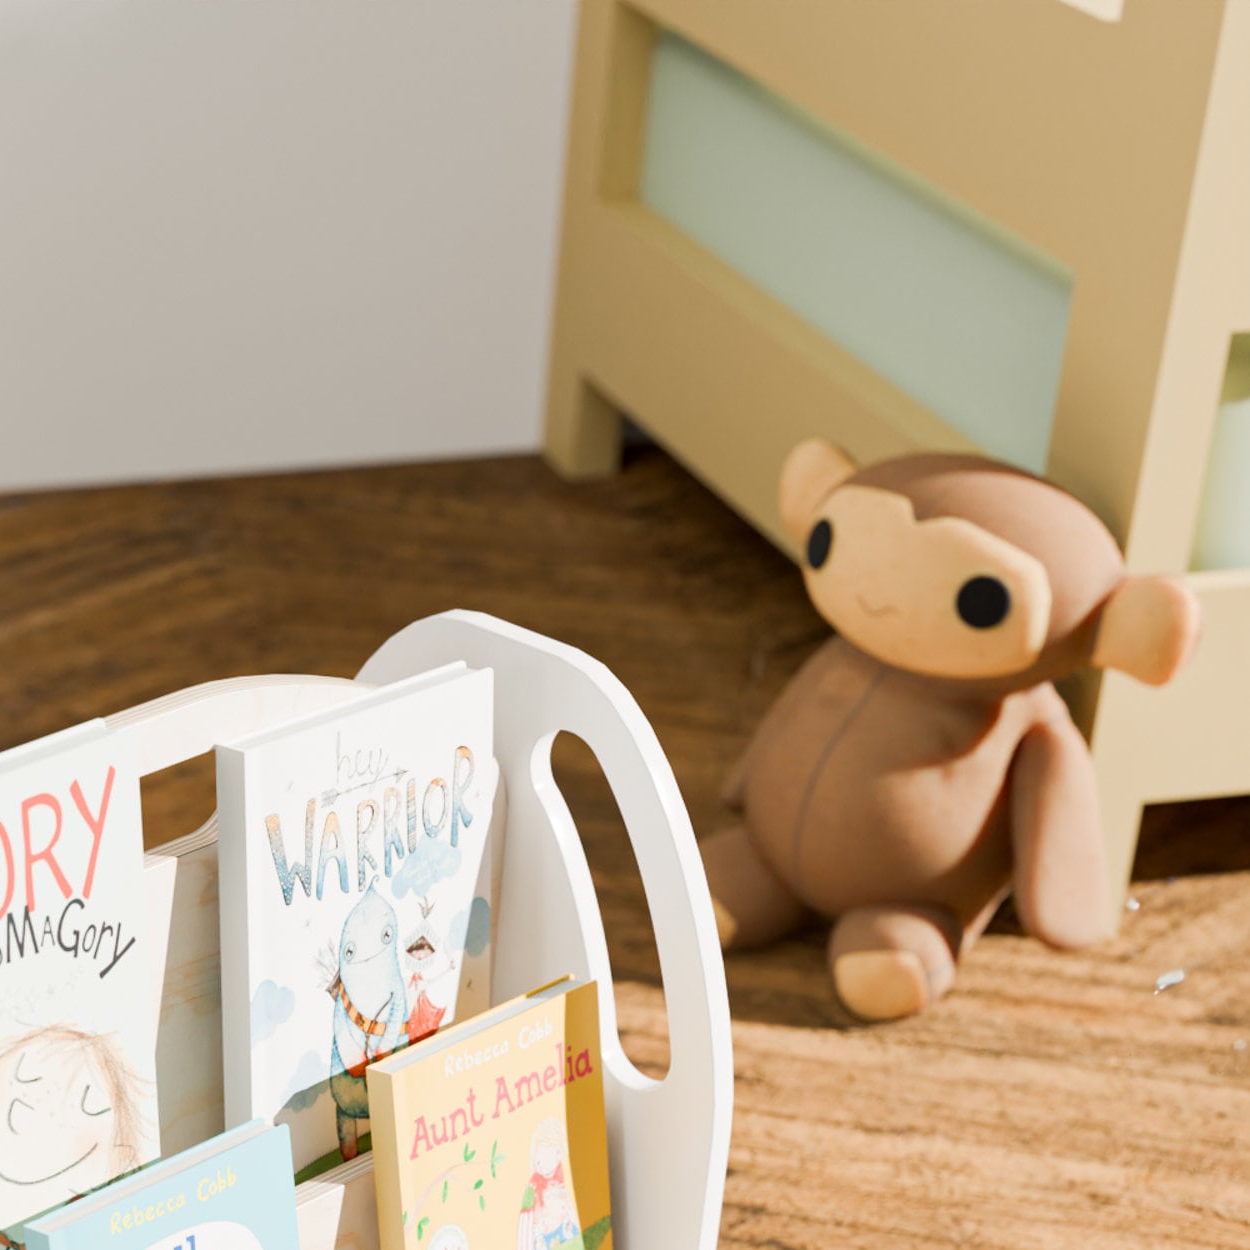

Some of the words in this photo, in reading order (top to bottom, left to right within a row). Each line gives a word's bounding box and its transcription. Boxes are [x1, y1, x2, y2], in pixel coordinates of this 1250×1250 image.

[265, 745, 475, 906] WARRIOR
[444, 1040, 510, 1078] Rebecca
[517, 1016, 553, 1049] Cobb
[409, 1087, 485, 1161] Aunt
[492, 1042, 594, 1119] Amelia
[109, 1192, 187, 1236] Rebecca
[196, 1165, 238, 1202] Cobb
